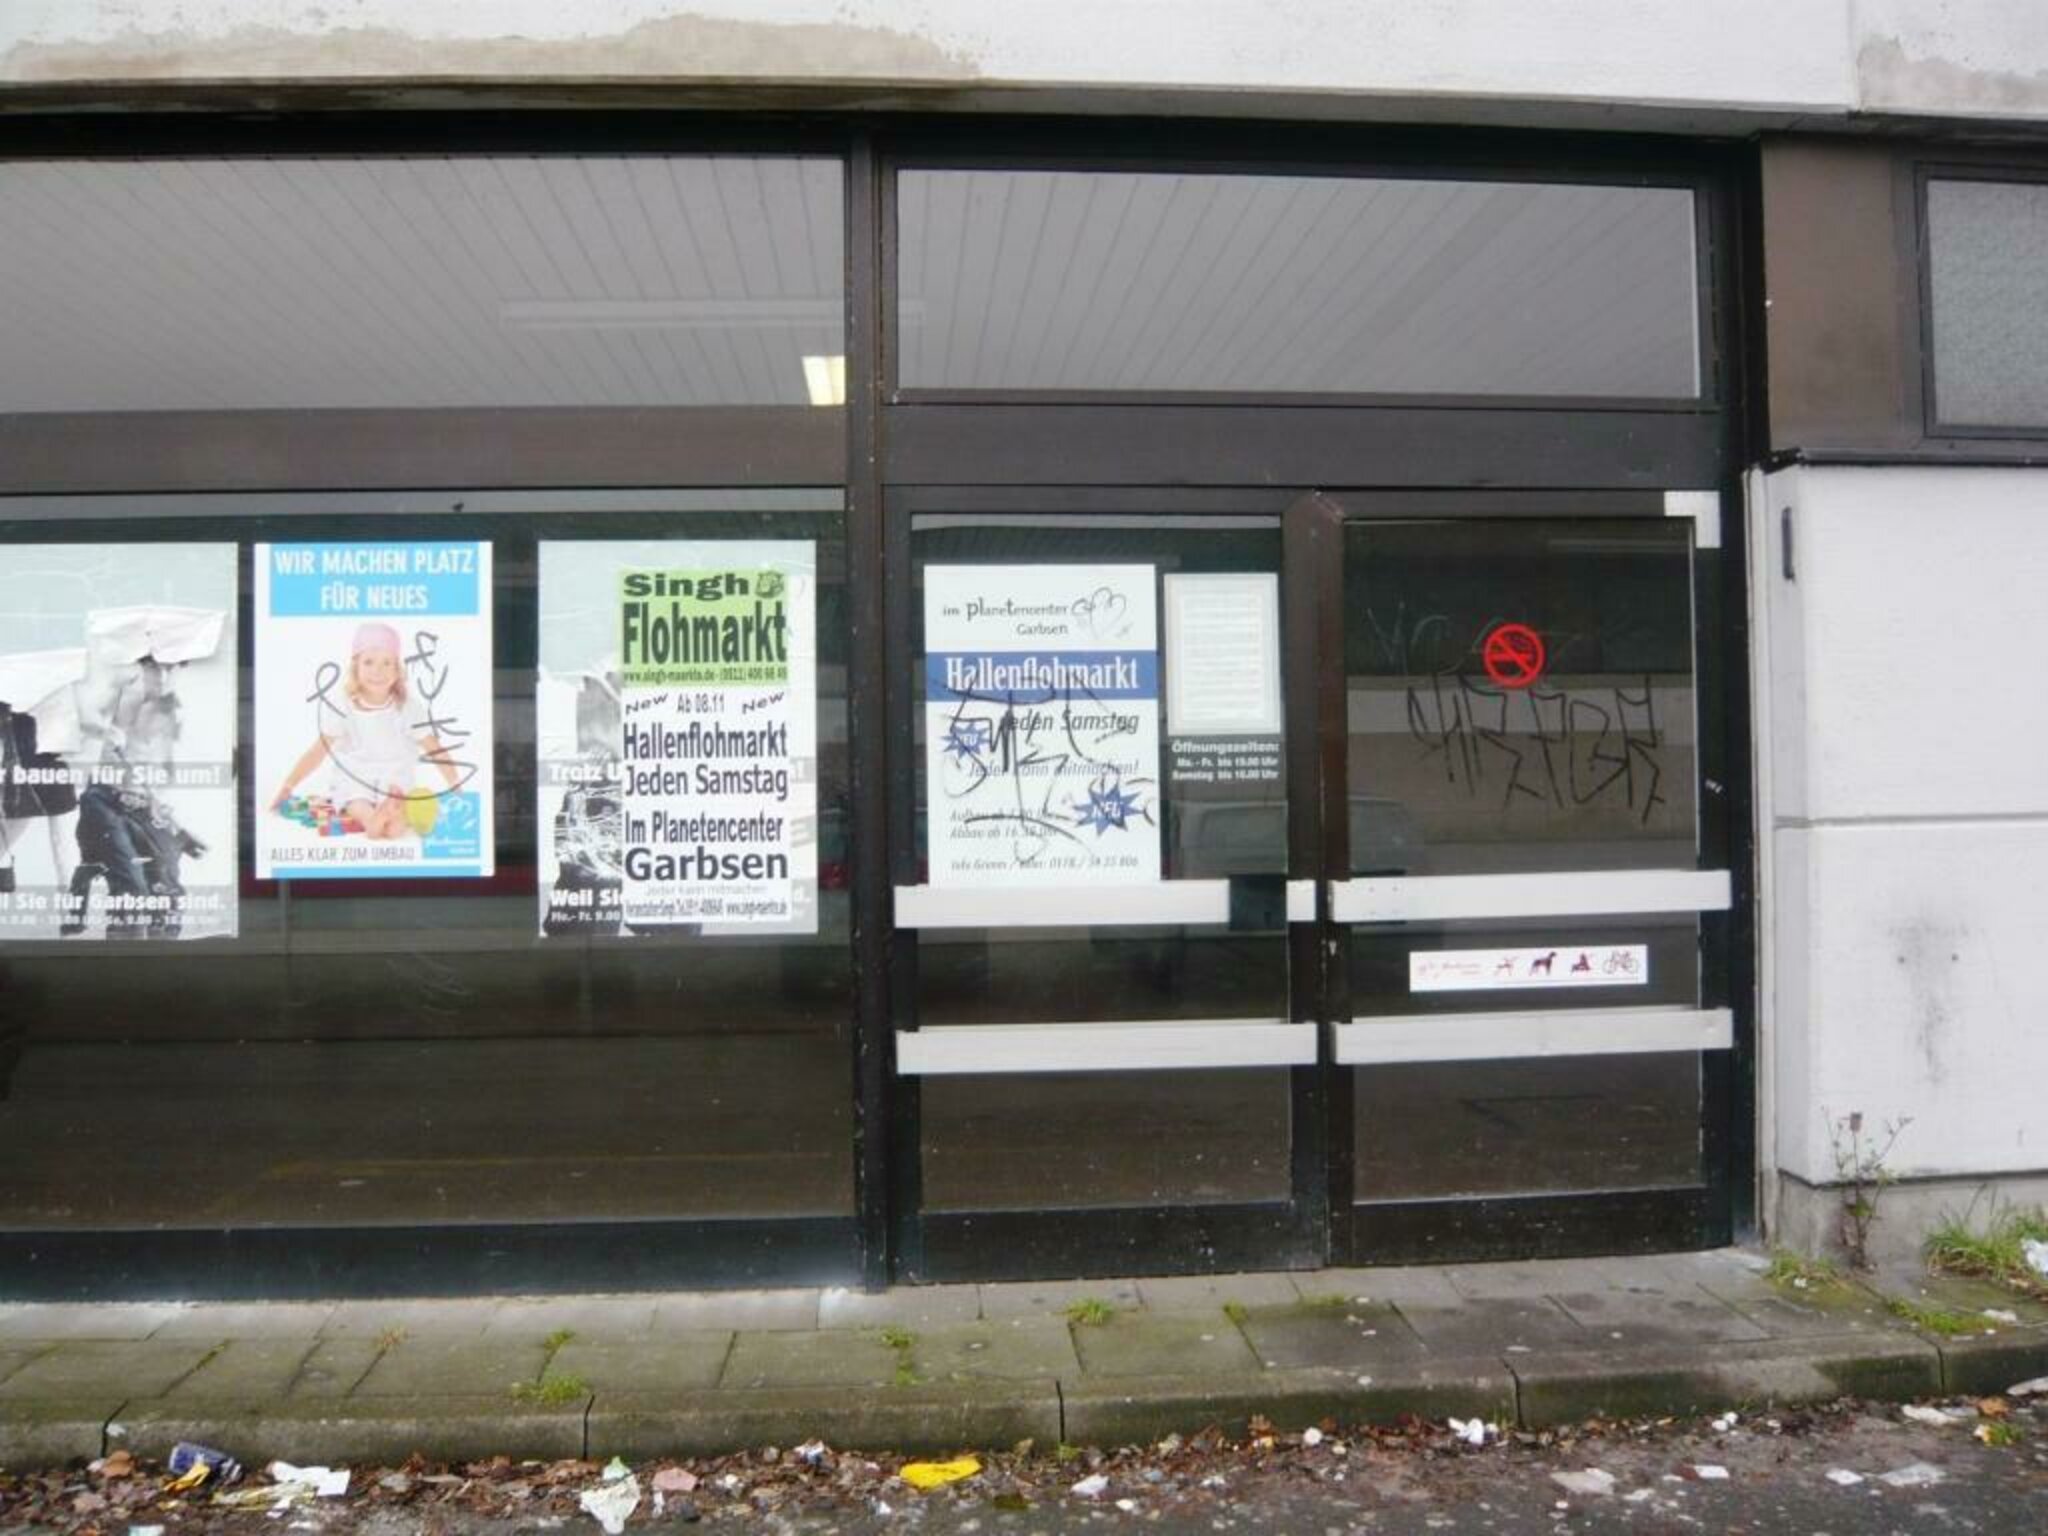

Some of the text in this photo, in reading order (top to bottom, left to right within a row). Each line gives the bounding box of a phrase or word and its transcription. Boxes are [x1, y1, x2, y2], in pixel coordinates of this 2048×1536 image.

[275, 549, 476, 575] WIR MACHEN PLATZ
[320, 580, 429, 610] FÜR NEUES
[623, 573, 750, 601] Singh
[943, 605, 960, 617] im
[623, 601, 788, 665] Flohmarkt
[1016, 622, 1069, 636] Garbsen
[945, 656, 1140, 691] Hallenflohmarkt
[626, 692, 668, 715] New
[677, 693, 691, 713] Ab
[742, 691, 785, 715] New
[1003, 709, 1140, 734] eden Samstag
[623, 721, 788, 760] Hallenflohmarkt
[13, 764, 83, 785] bauen
[92, 764, 126, 785] für
[132, 764, 168, 785] Sie
[175, 764, 221, 785] um!
[625, 766, 689, 797] Jeden
[696, 763, 789, 802] Samstag
[625, 810, 783, 844] Im Planetencenter
[271, 846, 415, 861] ALLES KLAR ZUM UMBAU
[625, 846, 789, 882] Garbsen
[15, 893, 48, 911] Sie
[53, 893, 84, 911] für
[92, 892, 171, 911] Garbsen
[177, 892, 225, 911] sind.
[550, 888, 623, 906] Weil Si
